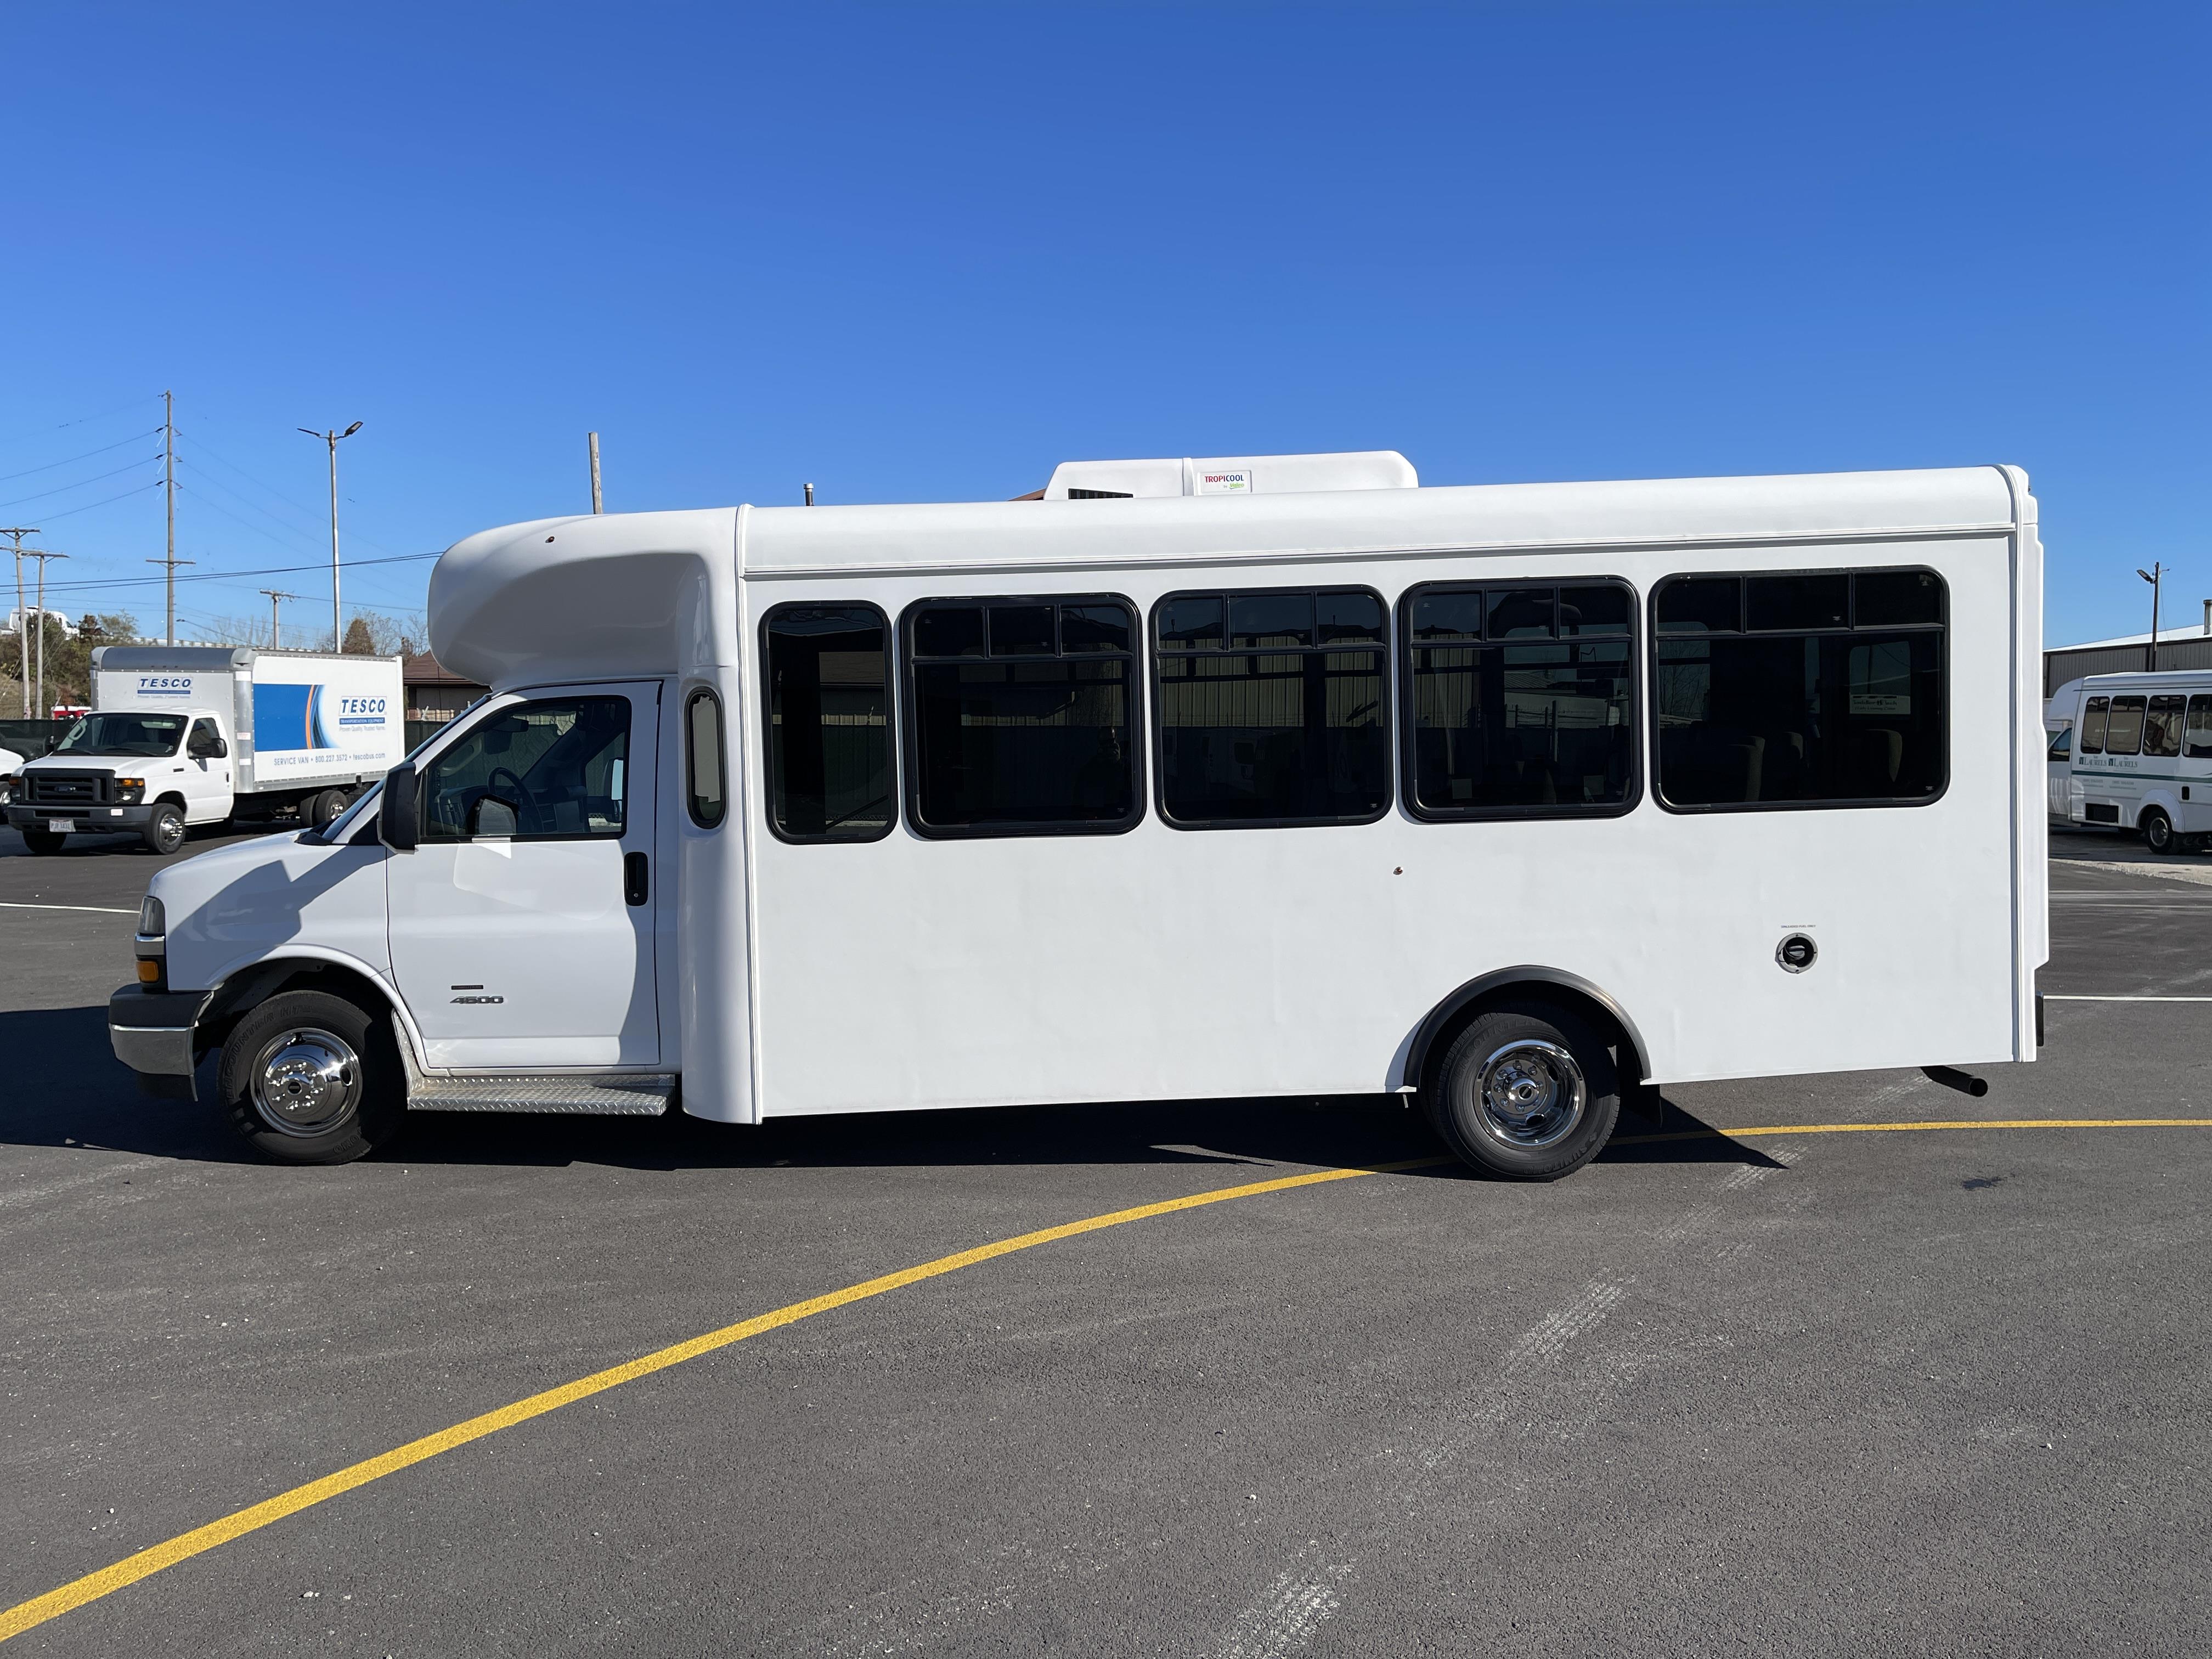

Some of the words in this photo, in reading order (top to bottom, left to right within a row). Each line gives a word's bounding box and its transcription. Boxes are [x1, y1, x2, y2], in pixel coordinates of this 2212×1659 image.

[1204, 475, 1244, 483] TROPICOOL
[140, 678, 191, 687] TESCO
[342, 699, 385, 713] TESCO
[450, 996, 504, 1005] 4500
